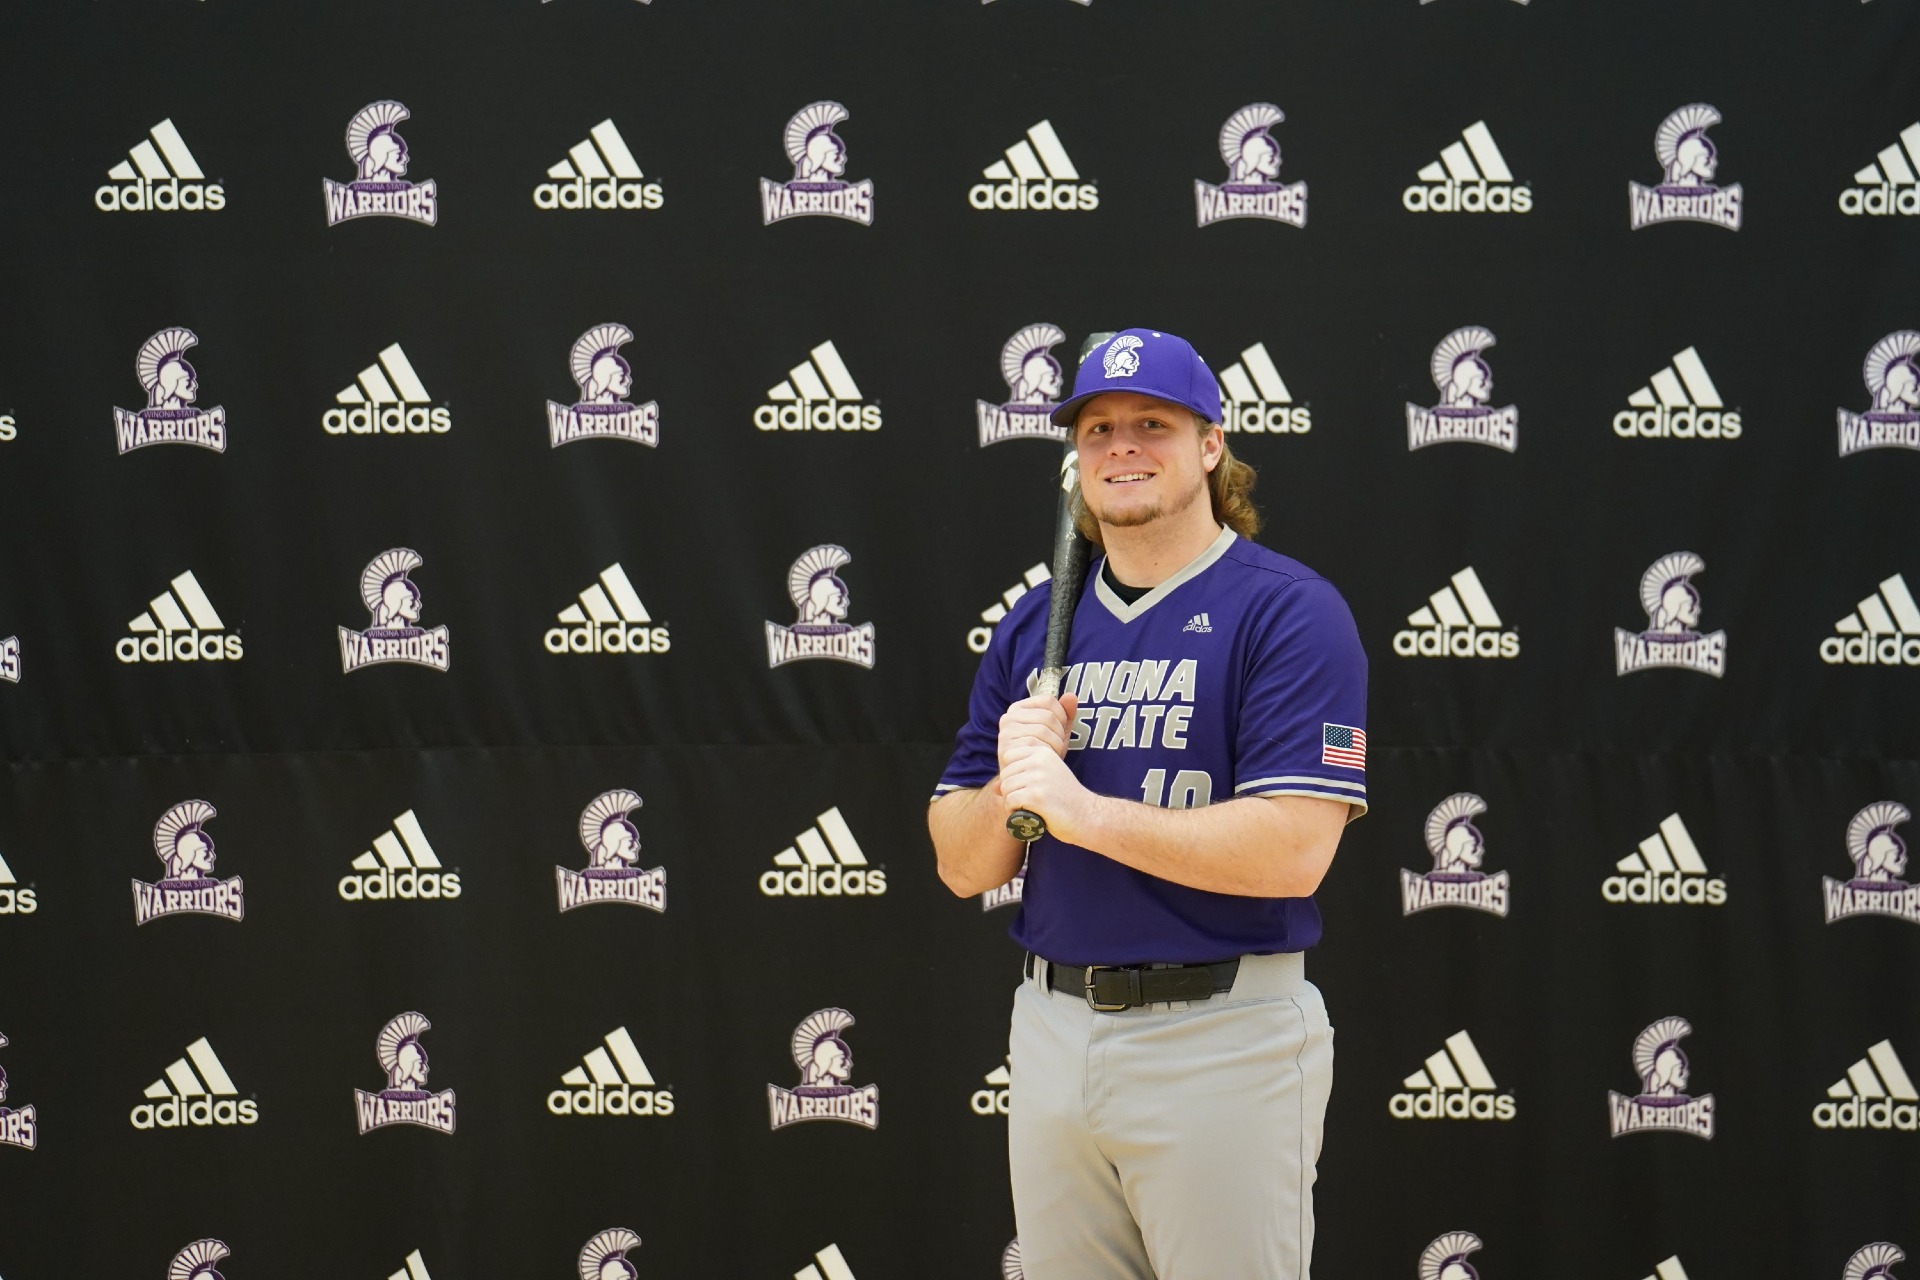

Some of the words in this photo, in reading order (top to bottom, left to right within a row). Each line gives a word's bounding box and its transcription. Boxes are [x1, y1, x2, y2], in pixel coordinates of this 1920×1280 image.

[95, 177, 226, 211] adidas
[325, 179, 435, 225] WARRIORS
[533, 175, 664, 209] adidas
[762, 179, 872, 224] WARRIORS
[968, 176, 1099, 210] adidas
[1197, 181, 1306, 226] WARRIORS
[1402, 179, 1533, 213] adidas
[1631, 183, 1741, 229] WARRIORS
[1839, 181, 1920, 215] adid
[115, 407, 224, 453] WARRIORS
[144, 410, 175, 418] WINONA
[177, 410, 197, 418] STATE
[322, 400, 451, 434] adidas
[549, 401, 657, 446] WARRIORS
[753, 397, 882, 431] adidas
[1221, 399, 1312, 434] didas
[1408, 404, 1516, 450] WARRIORS
[1613, 405, 1742, 439] adidas
[1839, 409, 1920, 455] WARRIO
[544, 619, 671, 653] adidas
[767, 622, 873, 667] WARRIORS
[1182, 621, 1213, 633] adidas
[1393, 624, 1520, 658] adidas
[116, 629, 243, 663] adidas
[340, 627, 448, 672] WARRIORS
[1617, 629, 1724, 676] WARRIORS
[1820, 630, 1920, 665] adida
[1067, 705, 1194, 750] STATE
[161, 881, 192, 889] WINONA
[193, 881, 213, 889] STATE
[338, 866, 461, 900] adidas
[558, 867, 664, 911] WARRIORS
[759, 862, 887, 896] adidas
[1403, 870, 1507, 915] WARRIORS
[1602, 870, 1727, 904] adidas
[134, 877, 242, 924] WARRIORS
[1824, 877, 1920, 923] WARRIOR
[130, 1095, 258, 1129] adidas
[357, 1090, 454, 1133] WARRIORS
[547, 1082, 674, 1116] adidas
[770, 1085, 877, 1128] WARRIORS
[1389, 1086, 1516, 1120] adidas
[1611, 1092, 1712, 1137] WARRIORS
[1812, 1095, 1920, 1131] adida
